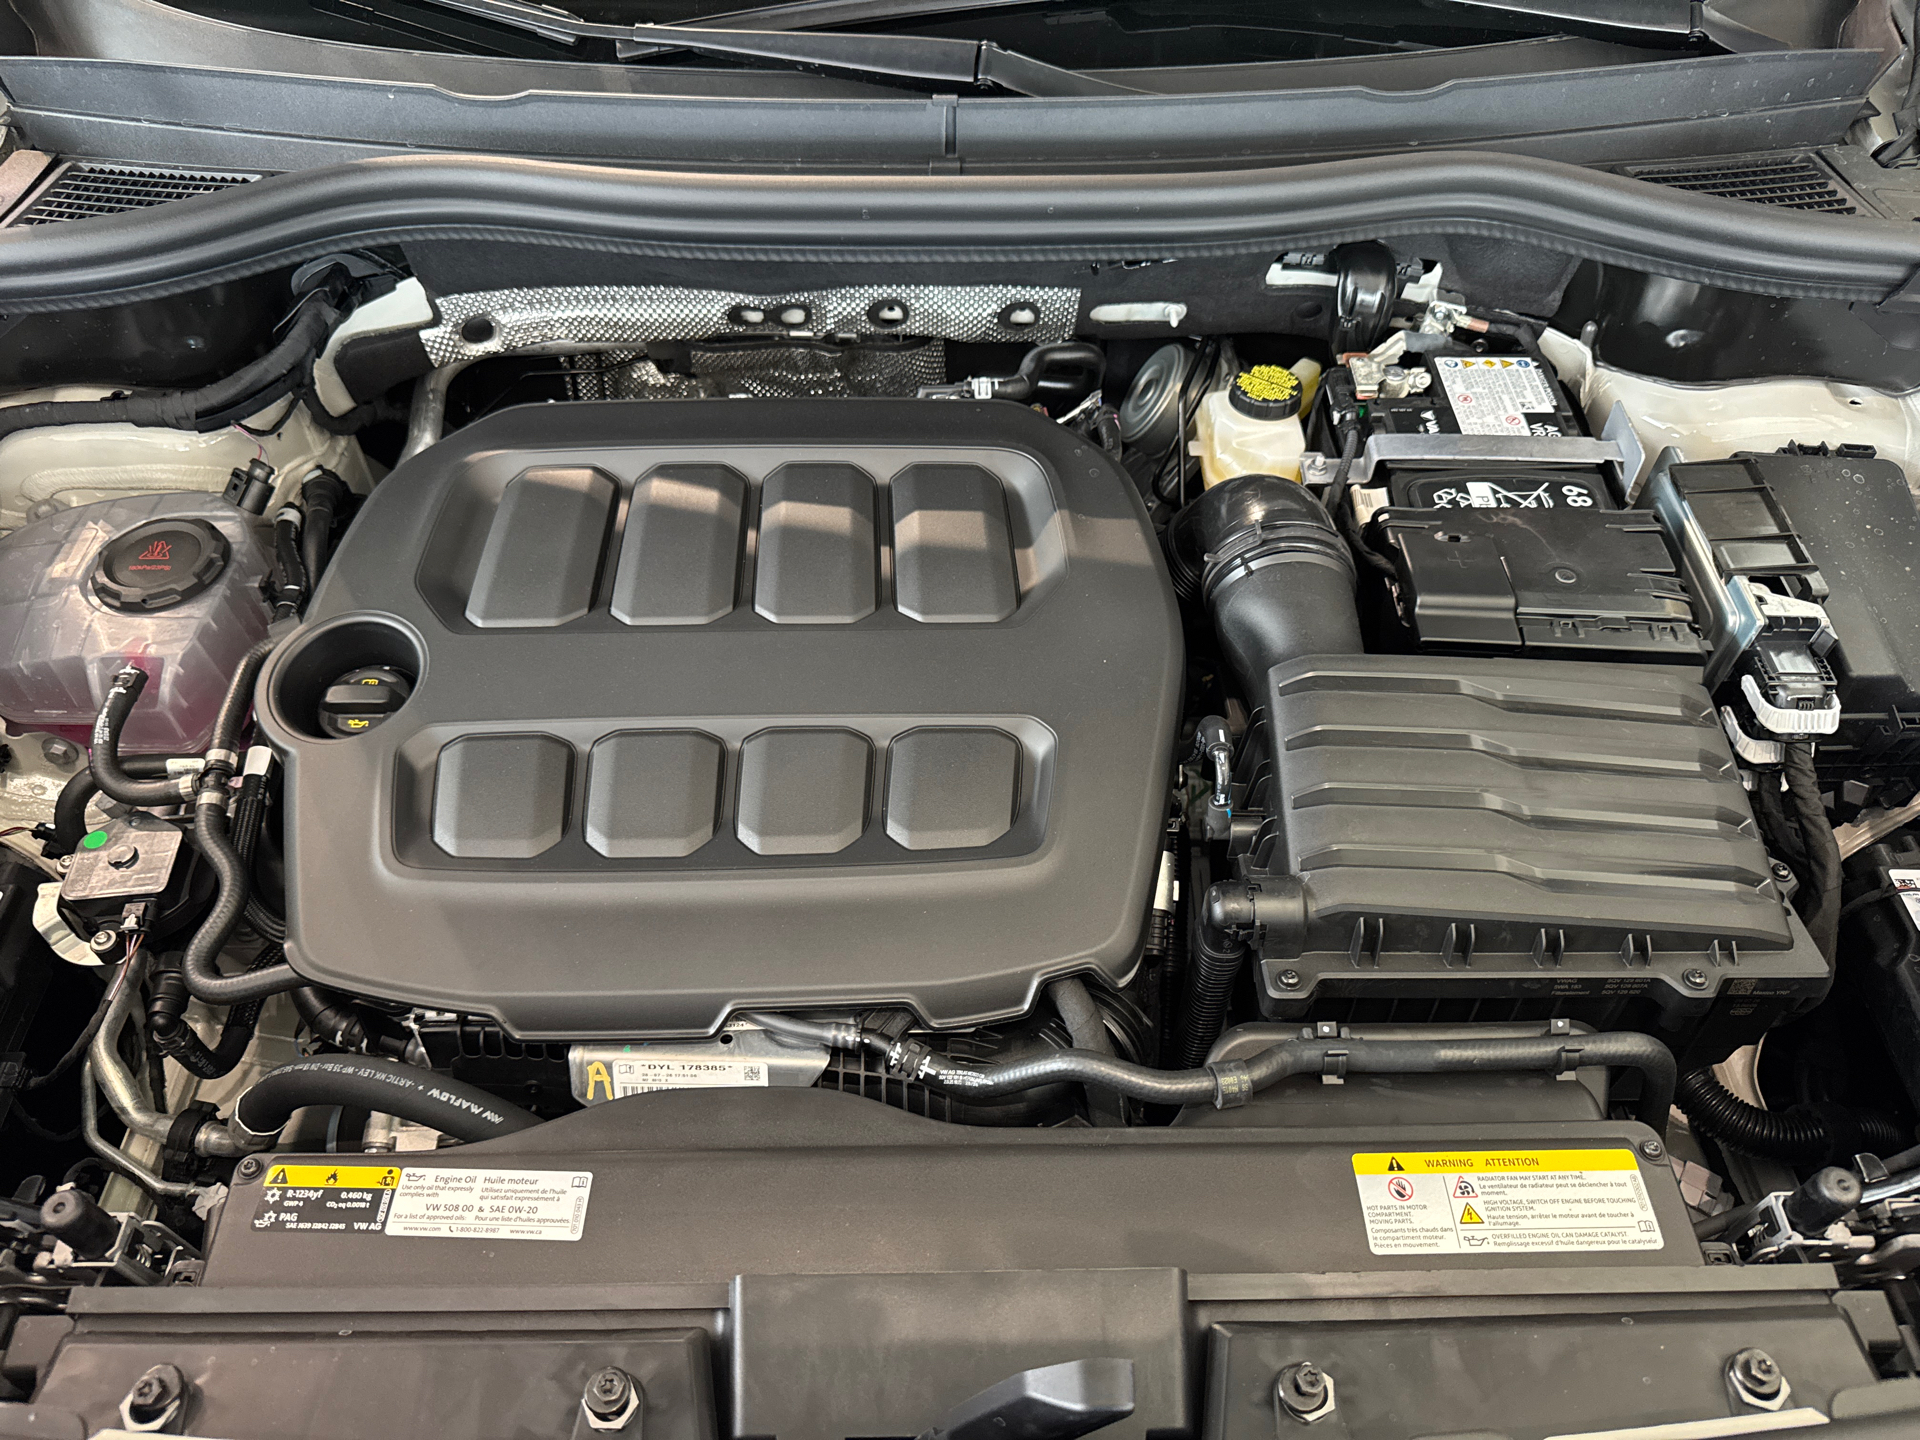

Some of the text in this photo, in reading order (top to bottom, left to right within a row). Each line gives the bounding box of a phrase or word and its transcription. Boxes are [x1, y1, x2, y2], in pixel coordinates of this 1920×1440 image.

[1562, 485, 1593, 507] 68
[587, 1061, 614, 1100] A
[426, 1088, 484, 1114] MAFLOW
[1424, 1158, 1539, 1168] WARNING ATTENTION
[434, 1175, 463, 1185] Engine
[484, 1176, 506, 1184] Huile
[286, 1190, 372, 1201] R-1234yf 0.460 kg
[490, 1205, 506, 1213] SAE
[508, 1206, 538, 1214] 0W-20
[279, 1212, 298, 1222] PAG
